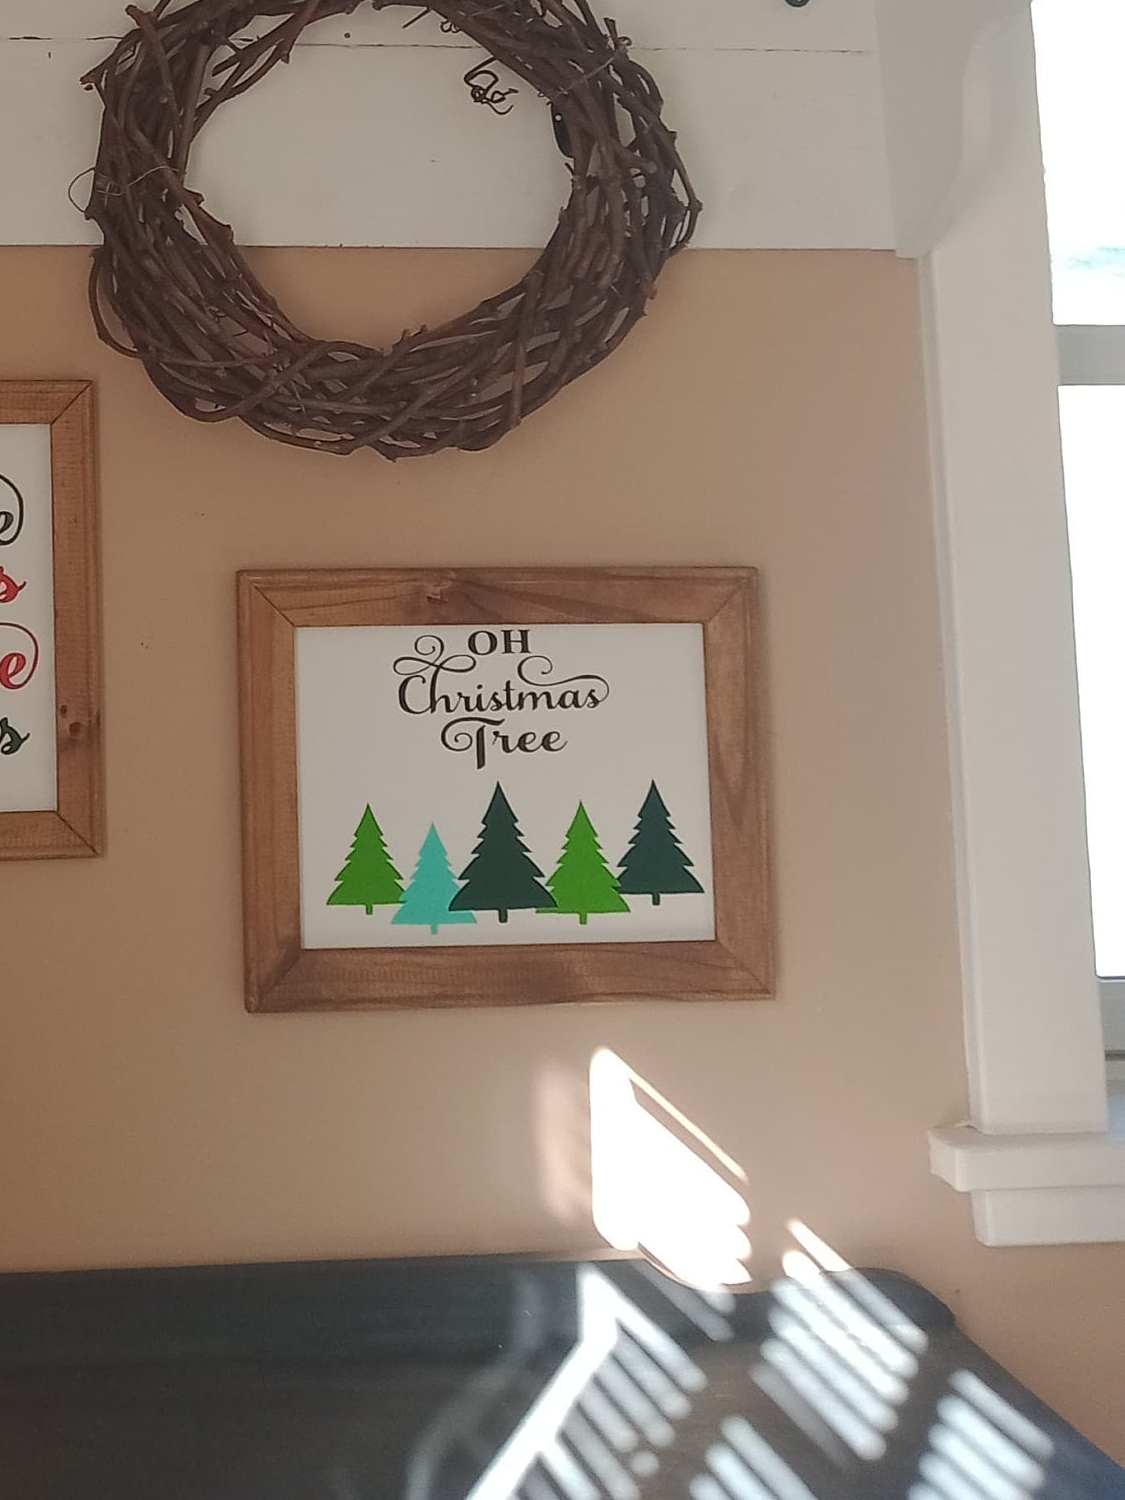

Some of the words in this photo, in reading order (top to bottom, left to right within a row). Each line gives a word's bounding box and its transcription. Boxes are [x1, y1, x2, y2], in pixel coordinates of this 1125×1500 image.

[468, 629, 531, 656] OH
[393, 635, 610, 714] Christmas
[440, 716, 568, 770] Tree
